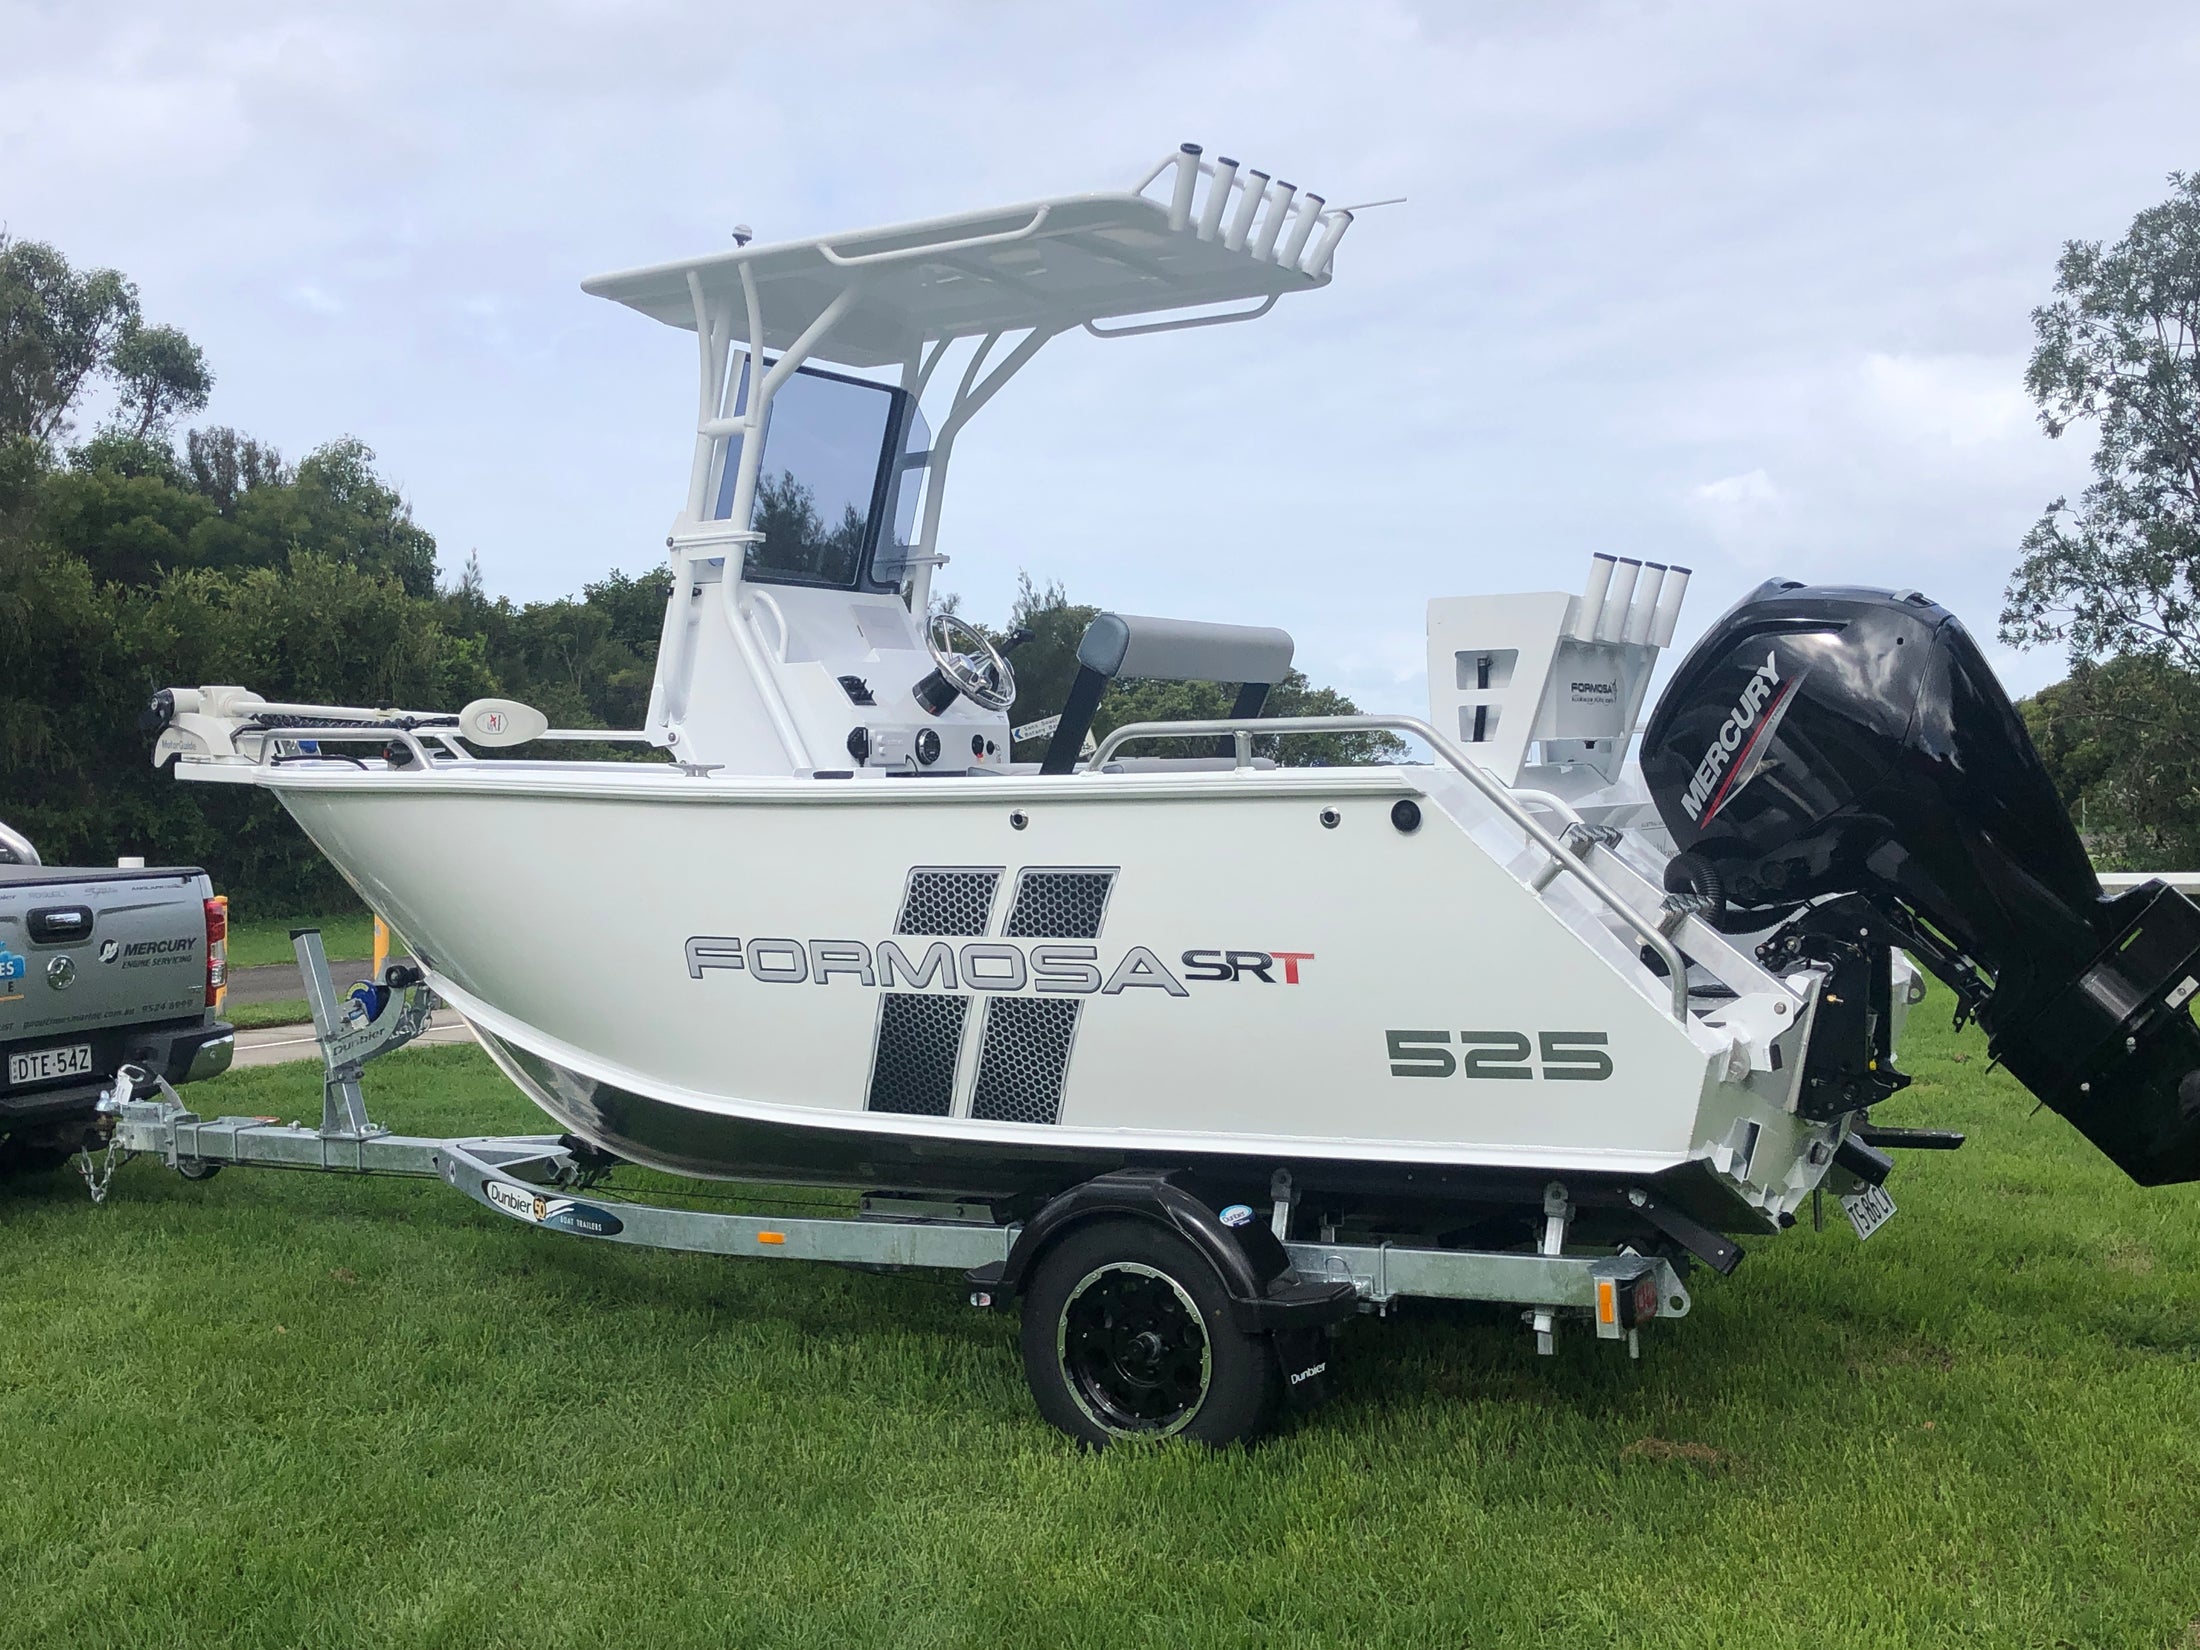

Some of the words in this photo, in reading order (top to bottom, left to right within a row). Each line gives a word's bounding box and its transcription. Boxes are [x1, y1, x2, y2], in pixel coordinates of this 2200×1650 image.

[1571, 682, 1612, 694] FORMOSA
[1681, 650, 1780, 821] MERCURY
[123, 937, 197, 957] MERCURY
[121, 959, 150, 970] ENGINE
[151, 955, 193, 967] SERVICING
[684, 936, 1190, 998] FORMOSA
[1185, 950, 1315, 984] SRT
[333, 1028, 386, 1056] Dunbier
[1385, 1030, 1613, 1081] 525
[491, 1185, 532, 1214] Dunbier
[560, 1215, 574, 1226] BOAT
[576, 1218, 602, 1232] TRAILERS
[1290, 1362, 1326, 1385] Dunbier
